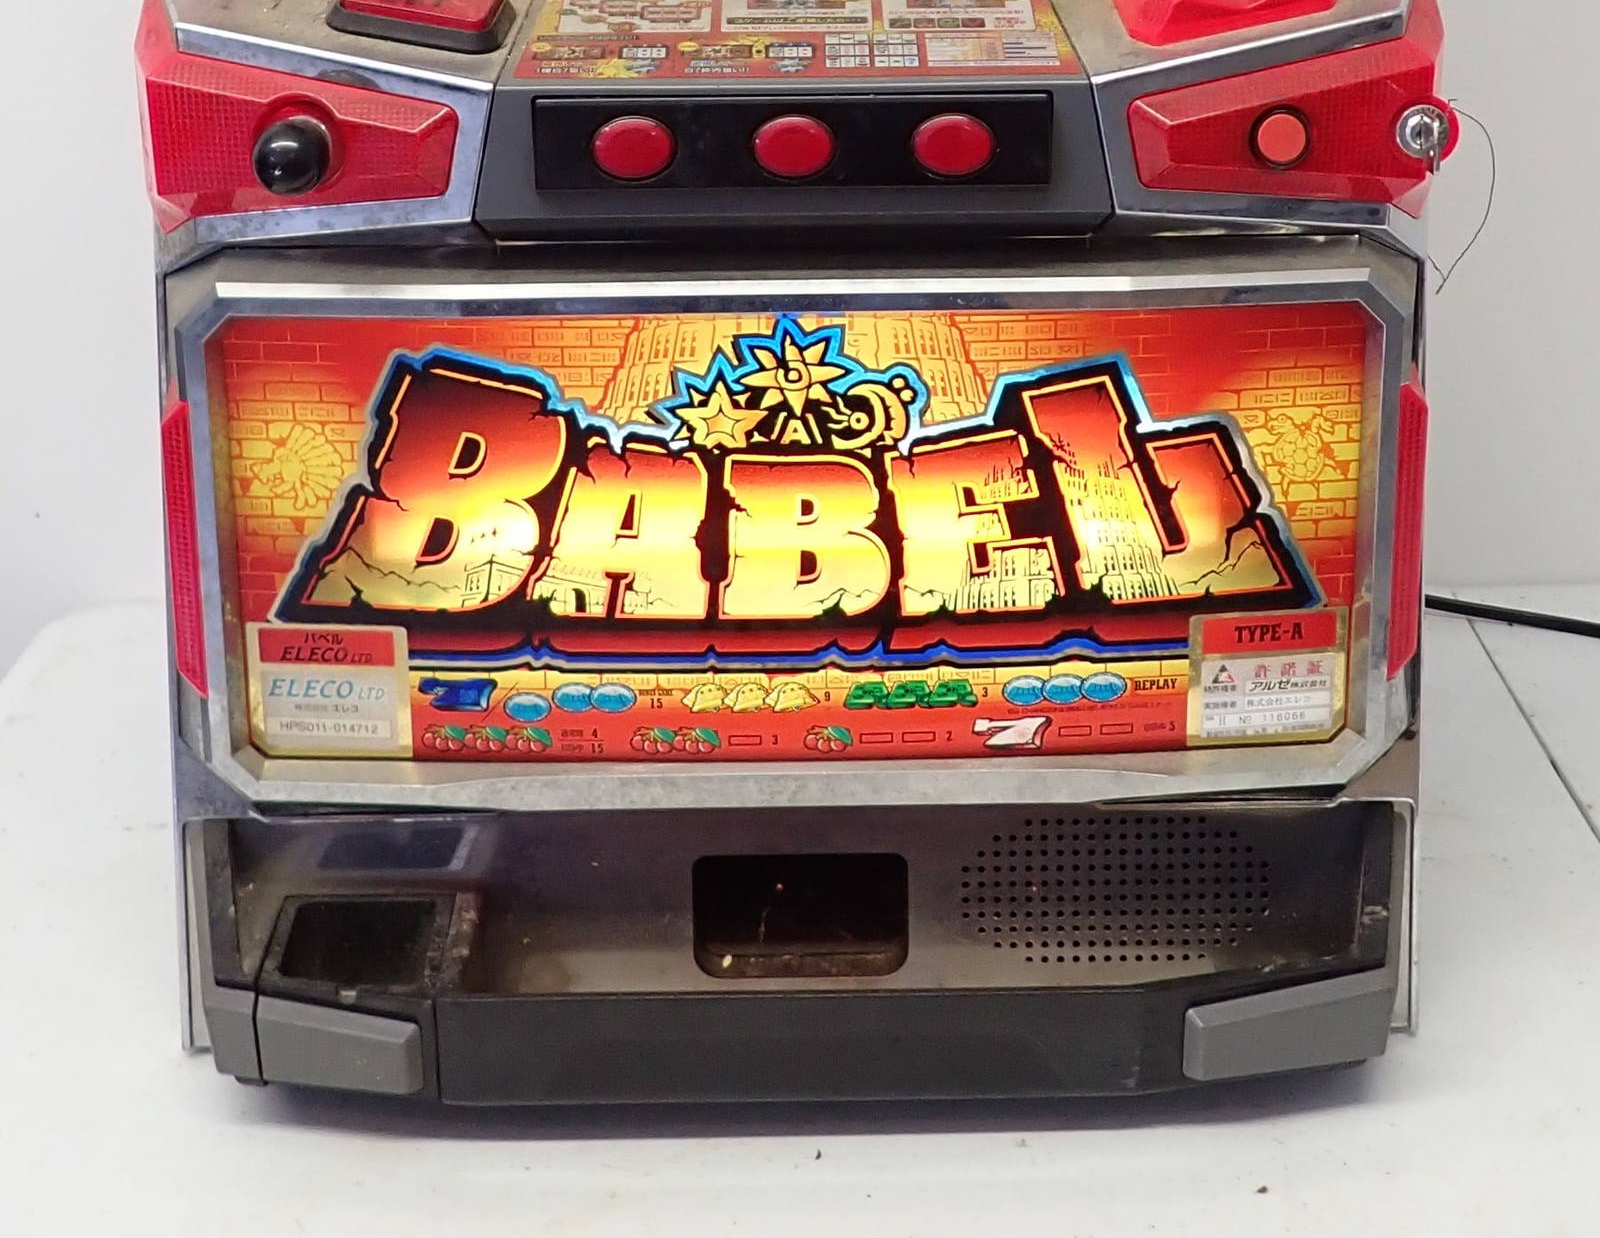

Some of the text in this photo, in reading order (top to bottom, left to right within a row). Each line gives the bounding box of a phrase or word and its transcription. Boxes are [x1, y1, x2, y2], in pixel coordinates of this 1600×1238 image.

[292, 360, 1308, 622] BABEL
[304, 632, 343, 645] バベル
[1234, 622, 1304, 644] TYPE-A
[280, 646, 373, 664] ELECO LTD
[268, 678, 386, 701] ELECO LTD
[1134, 678, 1178, 691] REPLAY
[824, 691, 831, 702] 9
[982, 686, 989, 698] 3
[650, 697, 664, 709] 15
[591, 728, 598, 739] 4
[946, 730, 952, 741] 2
[771, 735, 779, 746] 3
[591, 742, 604, 754] 15
